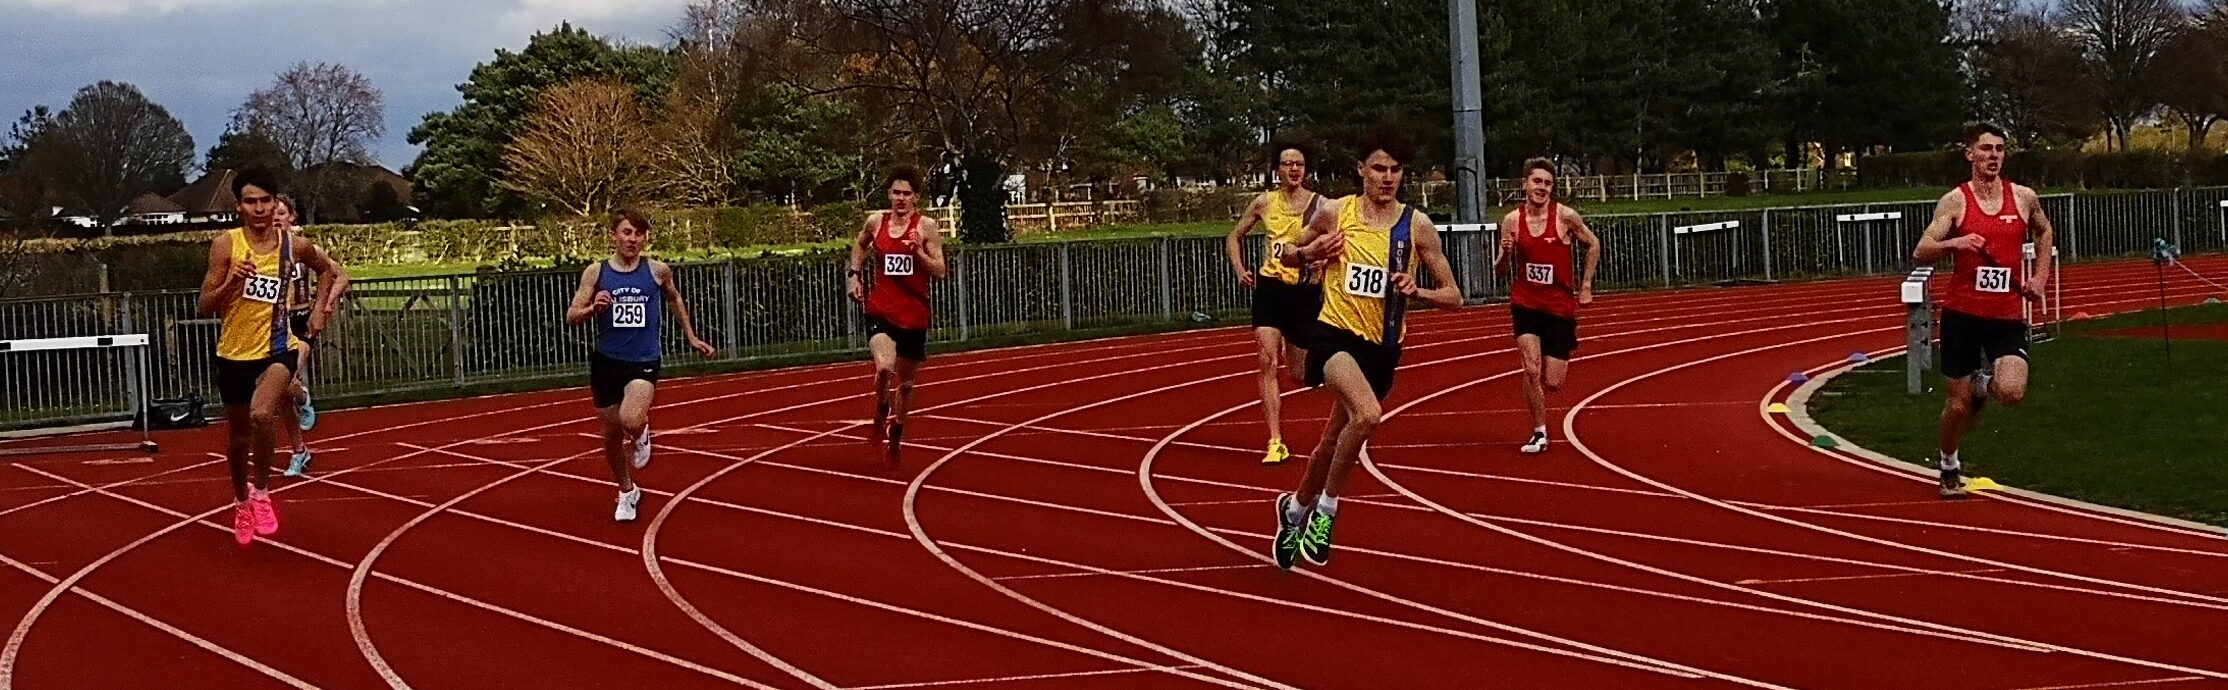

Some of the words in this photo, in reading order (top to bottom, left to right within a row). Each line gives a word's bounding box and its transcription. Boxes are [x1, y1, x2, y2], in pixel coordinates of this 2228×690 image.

[887, 256, 912, 273] 320
[1528, 265, 1552, 282] 337
[1349, 265, 1384, 294] 318
[1980, 269, 2008, 289] 331
[246, 277, 279, 300] 333
[612, 287, 631, 296] CITY
[613, 295, 650, 303] LISBURY
[615, 305, 643, 324] 259
